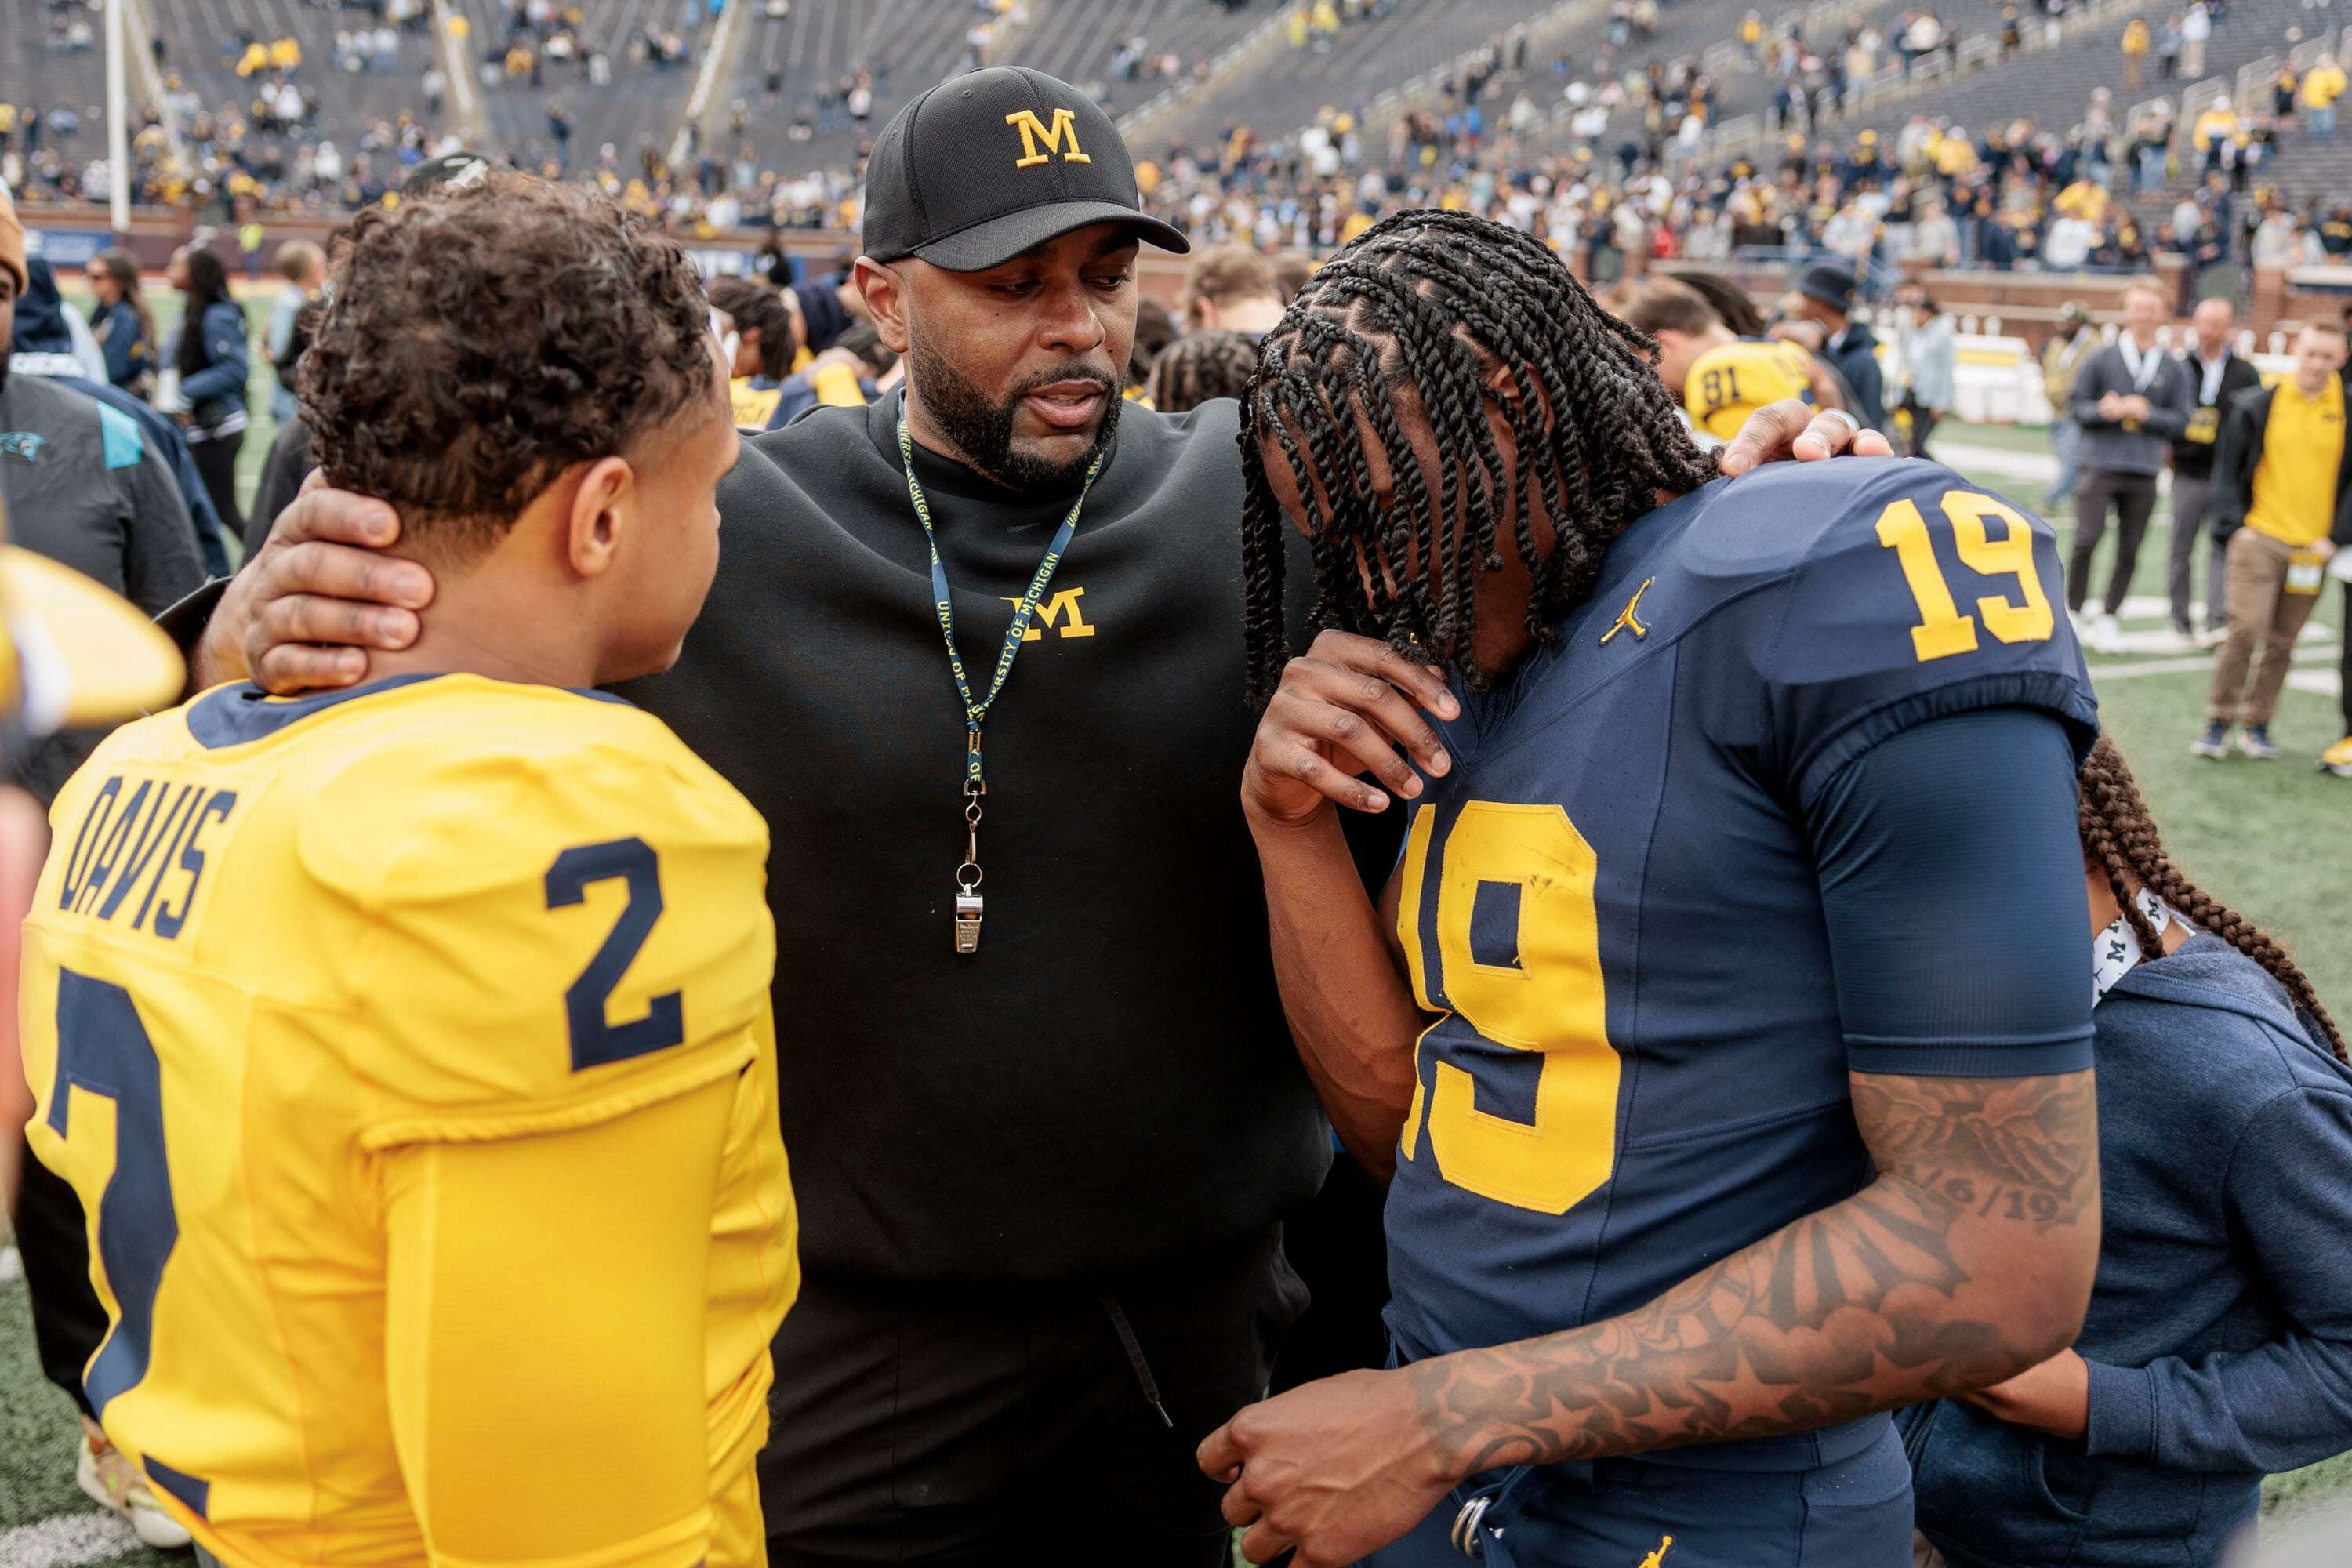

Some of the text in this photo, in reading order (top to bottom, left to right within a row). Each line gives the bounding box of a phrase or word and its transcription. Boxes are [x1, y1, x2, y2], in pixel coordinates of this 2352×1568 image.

[1006, 108, 1091, 168] M
[1704, 365, 1740, 406] 81
[1011, 619, 1025, 637] OF
[1020, 552, 1059, 615] MICHIGAN
[1874, 489, 2055, 662] 19
[1000, 586, 1095, 641] M
[952, 662, 966, 681] OF
[59, 776, 237, 939] DAVIS
[545, 836, 684, 1073] 2
[2106, 940, 2125, 963] M
